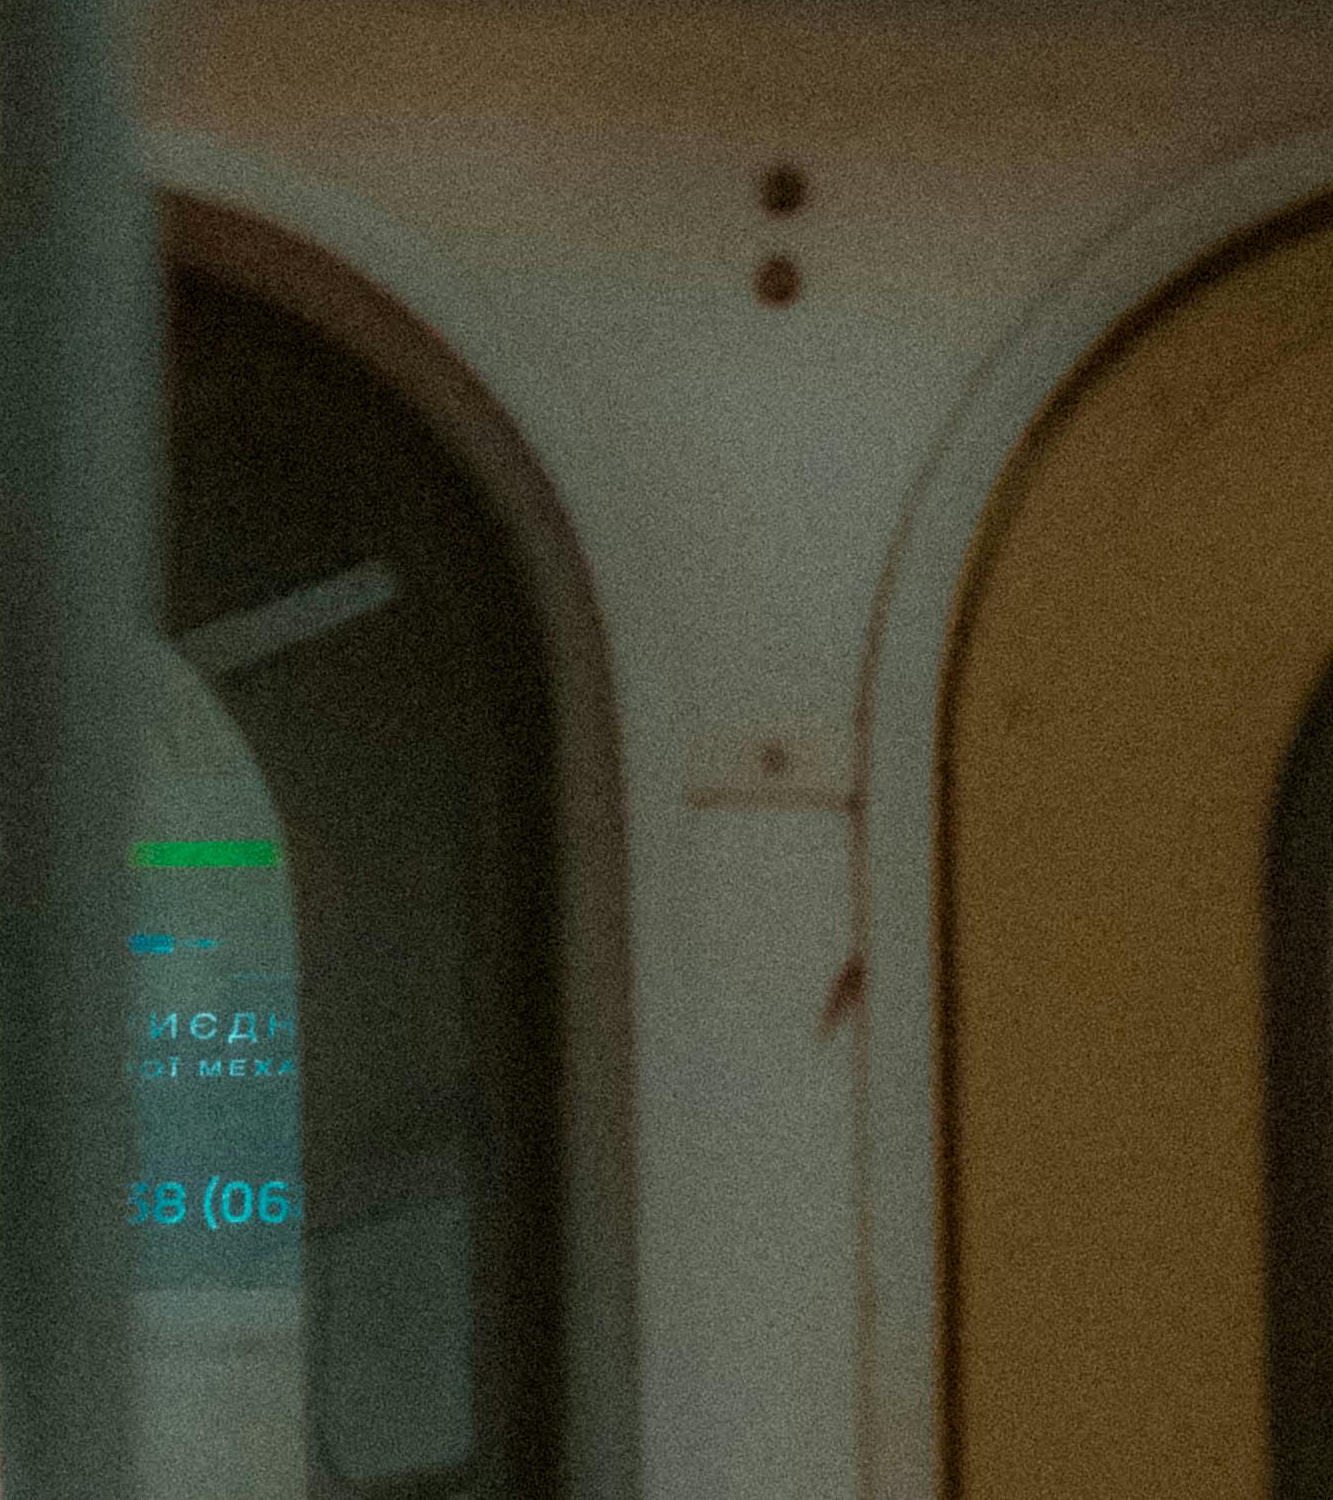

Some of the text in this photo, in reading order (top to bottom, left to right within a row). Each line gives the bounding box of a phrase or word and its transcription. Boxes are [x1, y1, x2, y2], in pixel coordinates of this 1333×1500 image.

[130, 1011, 296, 1044] ИЄДН
[129, 1056, 179, 1078] ОЇ
[203, 1174, 303, 1231] (06
